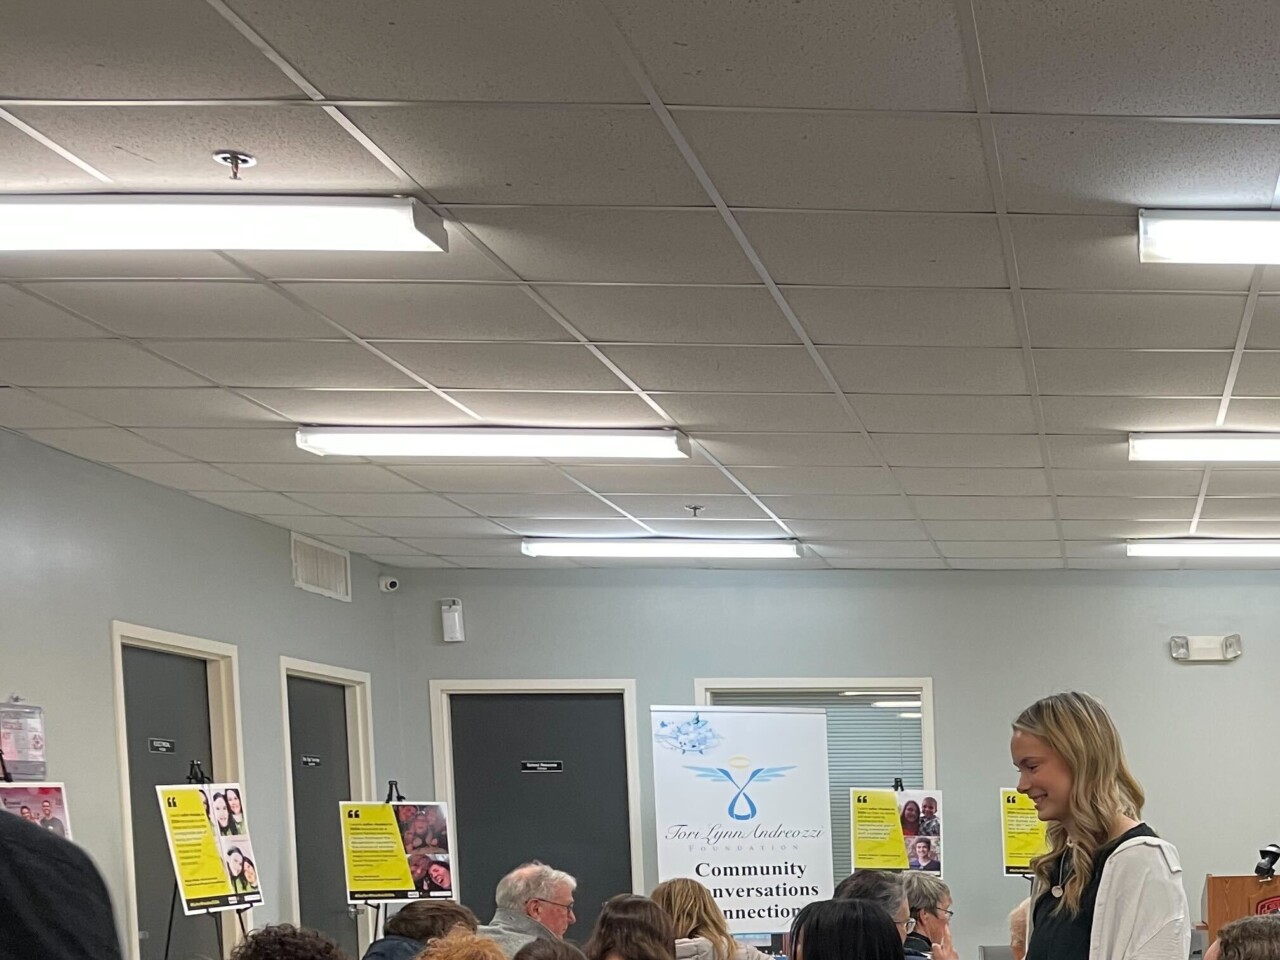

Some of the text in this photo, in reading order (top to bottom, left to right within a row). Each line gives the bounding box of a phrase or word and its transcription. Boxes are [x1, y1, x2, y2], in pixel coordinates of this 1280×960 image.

[665, 823, 824, 845] Tori Lynn Andreozzi
[688, 844, 800, 852] FOUNDATION
[695, 861, 807, 879] Community
[713, 883, 819, 898] nversations
